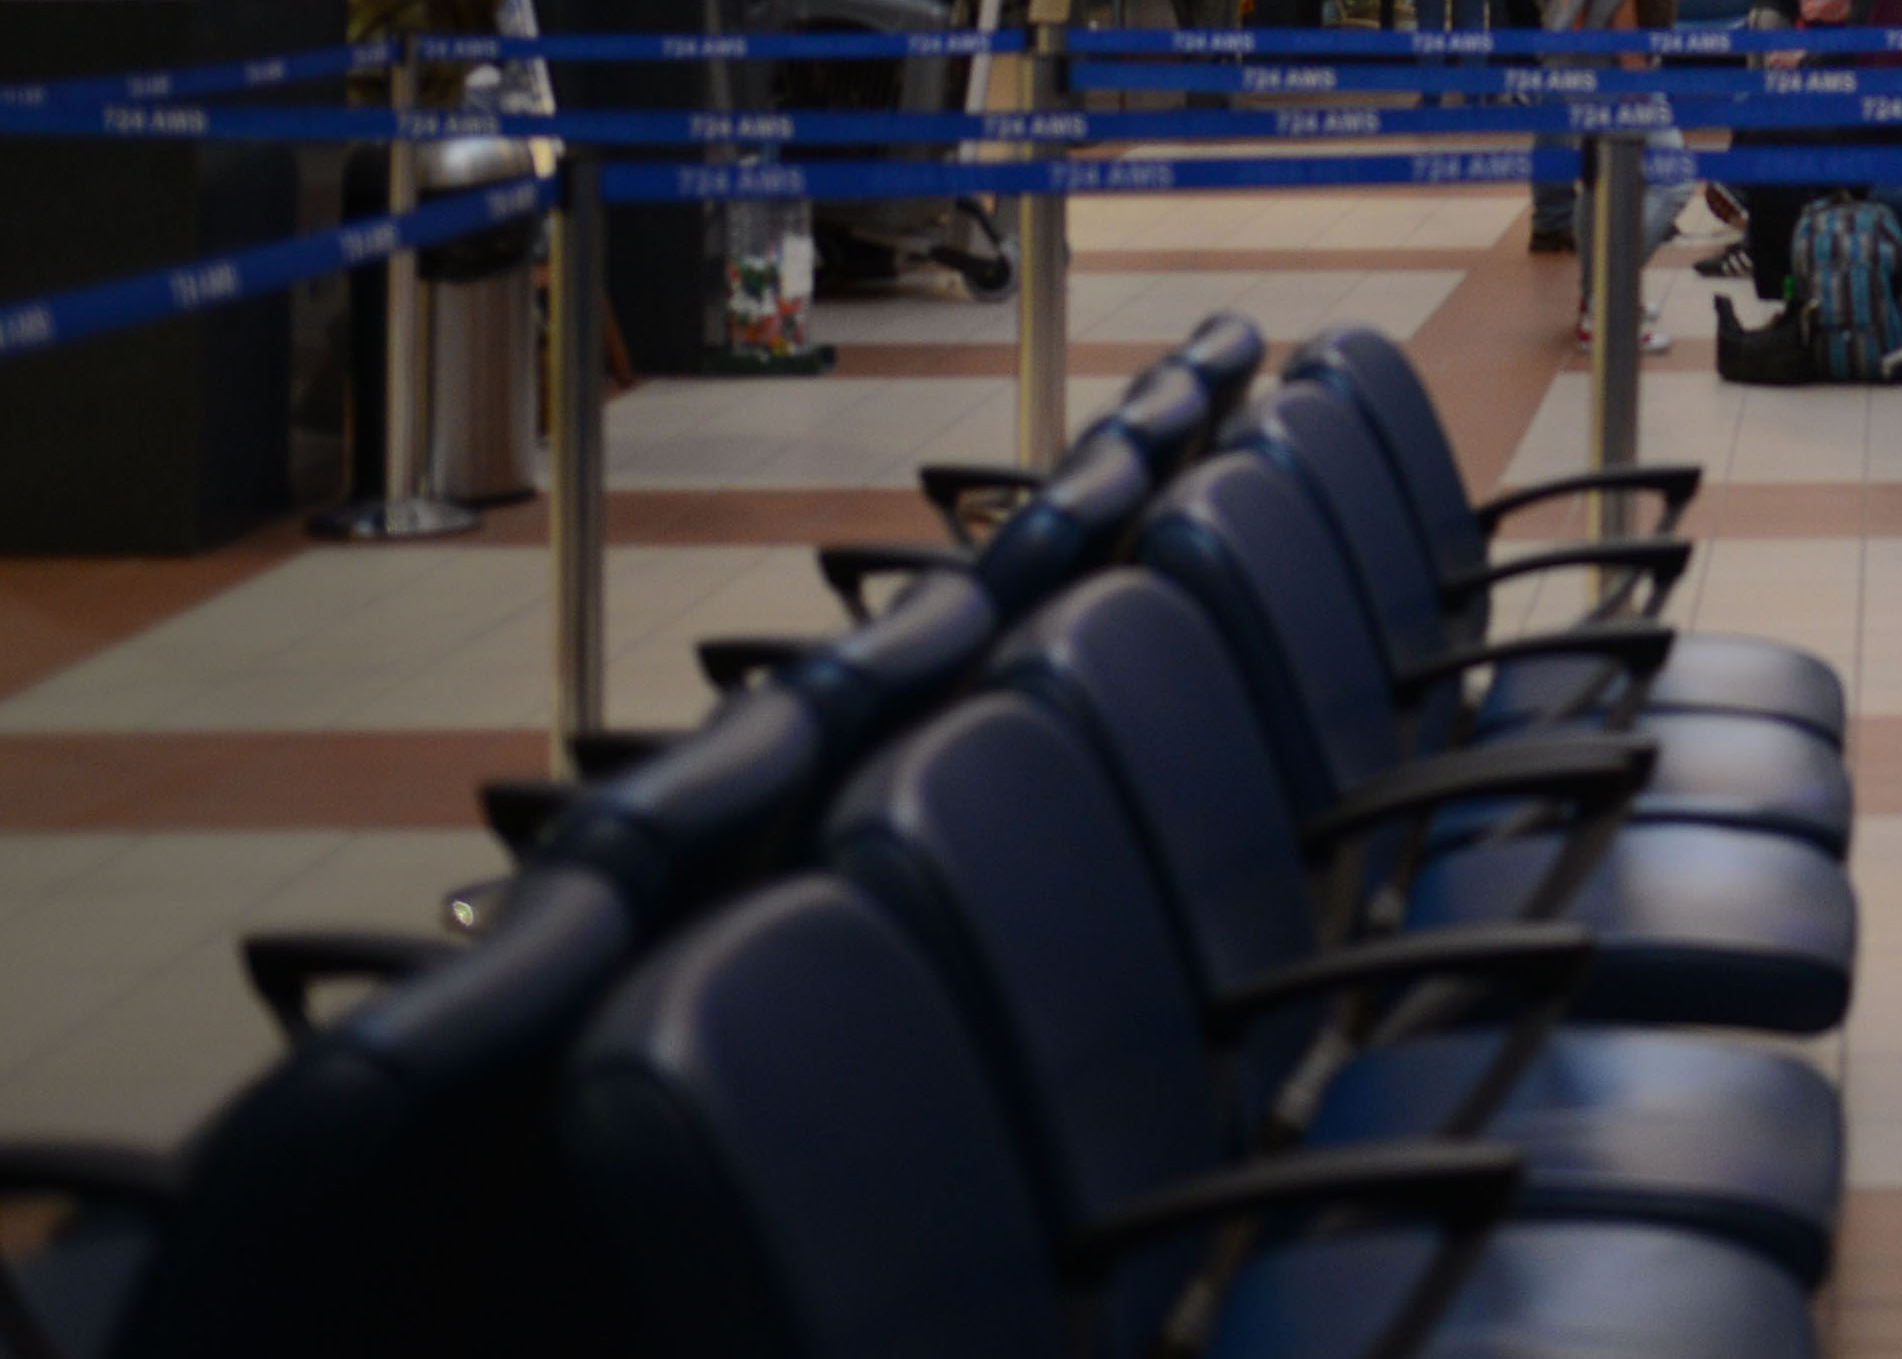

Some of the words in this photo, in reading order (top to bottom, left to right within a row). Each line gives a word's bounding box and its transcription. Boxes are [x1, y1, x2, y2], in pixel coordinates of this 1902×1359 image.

[422, 37, 446, 58] 24
[1173, 32, 1206, 53] 724
[1211, 32, 1255, 53] AMS
[1412, 32, 1445, 53] 724
[1449, 32, 1494, 53] AMS
[1649, 31, 1682, 52] 724
[1687, 31, 1730, 52] AMS
[1243, 66, 1281, 89] 724
[1285, 66, 1336, 89] AMS
[1505, 68, 1543, 91] 724
[1547, 68, 1597, 91] AMS
[1764, 70, 1802, 93] 724
[1806, 70, 1856, 93] AMS
[103, 107, 147, 135] 724
[152, 107, 208, 135] AMS
[690, 114, 733, 139] 724
[738, 114, 793, 139] AMS
[1277, 113, 1320, 136] 724
[1324, 113, 1379, 136] AMS
[1569, 104, 1612, 128] 724
[1617, 104, 1672, 128] AMS
[1645, 153, 1698, 180] MS
